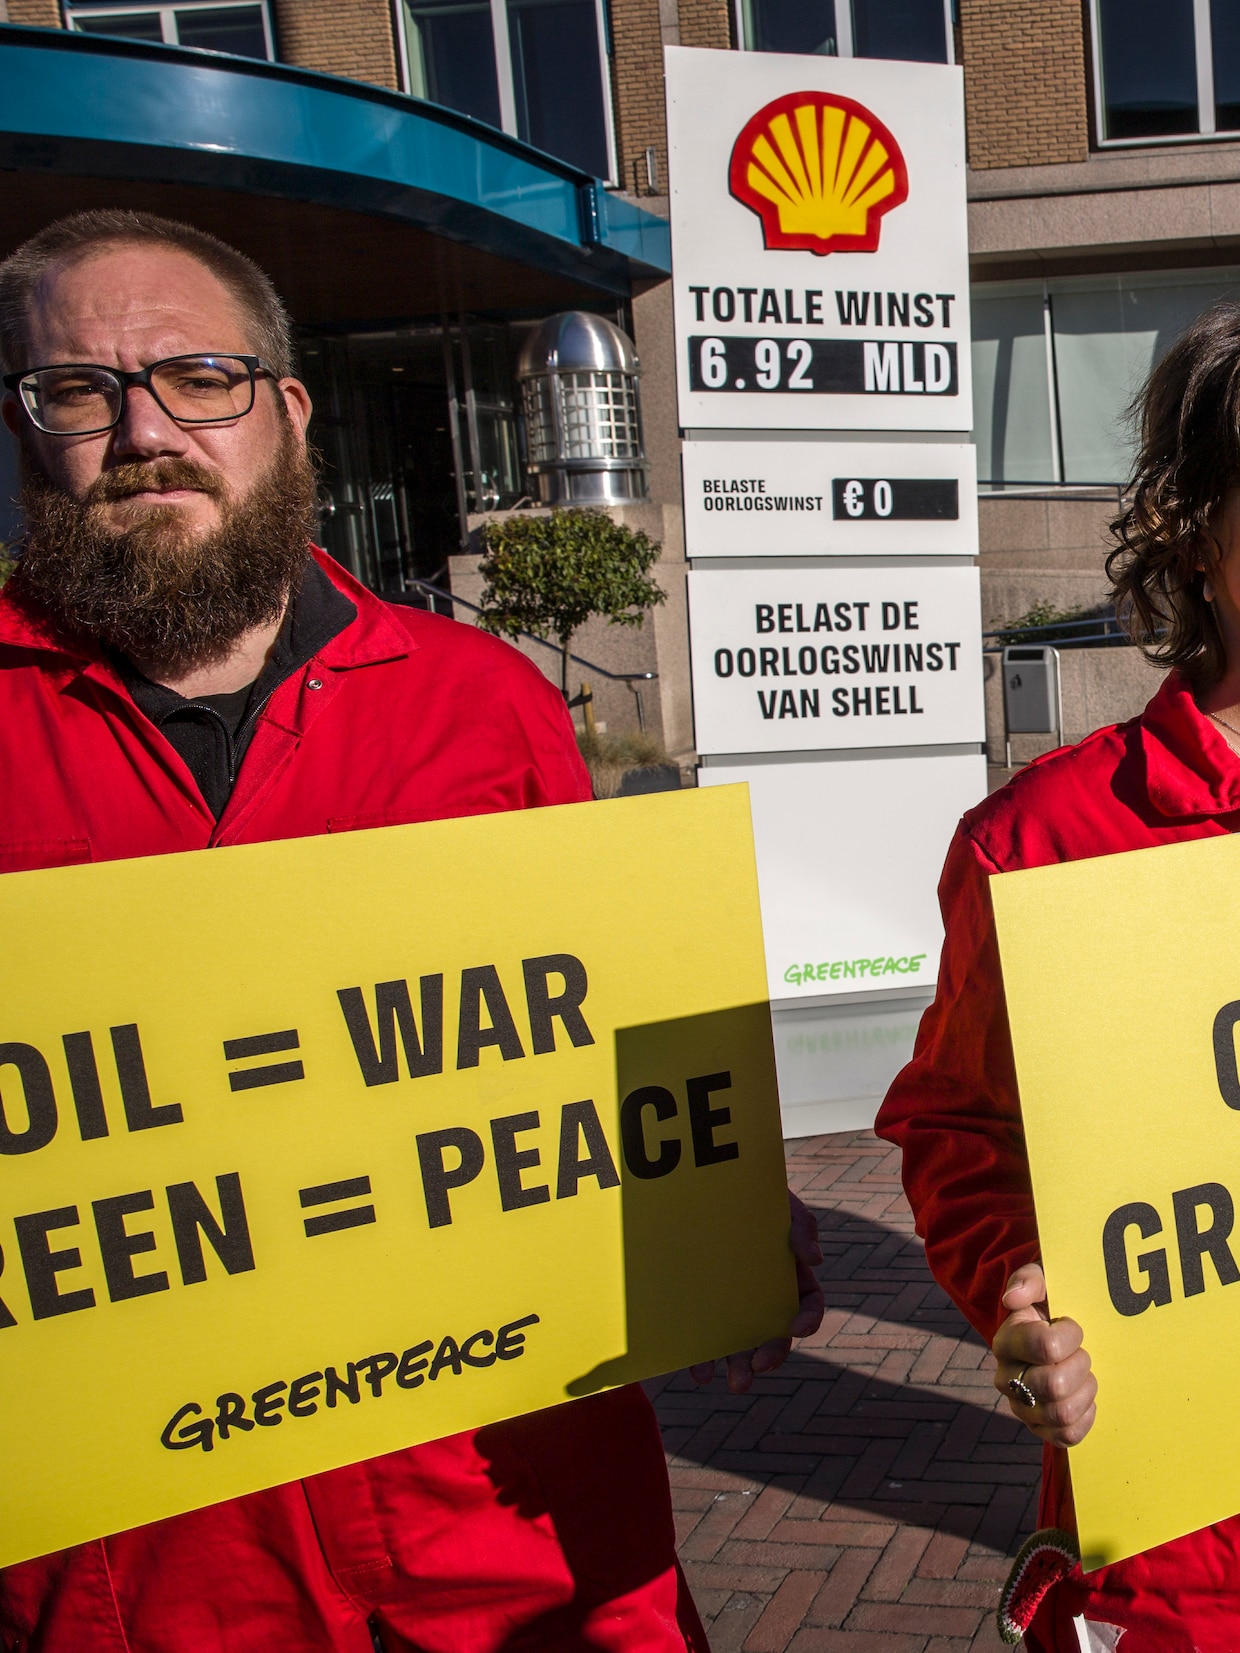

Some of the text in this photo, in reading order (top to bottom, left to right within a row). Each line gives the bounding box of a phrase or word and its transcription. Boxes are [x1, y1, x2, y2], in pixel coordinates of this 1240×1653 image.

[688, 286, 956, 328] TOTALE WINST
[700, 338, 951, 392] 6.92 MLD
[703, 479, 766, 494] BELASTE
[704, 496, 823, 511] OORLOGSWINST
[755, 601, 919, 634] BELAST DE
[714, 642, 961, 678] OORLOGSWINST
[757, 685, 924, 719] VAN SHELL
[783, 953, 927, 986] GREENPEACE
[0, 1023, 184, 1156] OIL
[336, 953, 597, 1088] WAR
[415, 1071, 740, 1229] PEACE
[160, 1313, 540, 1453] GREENPEACE
